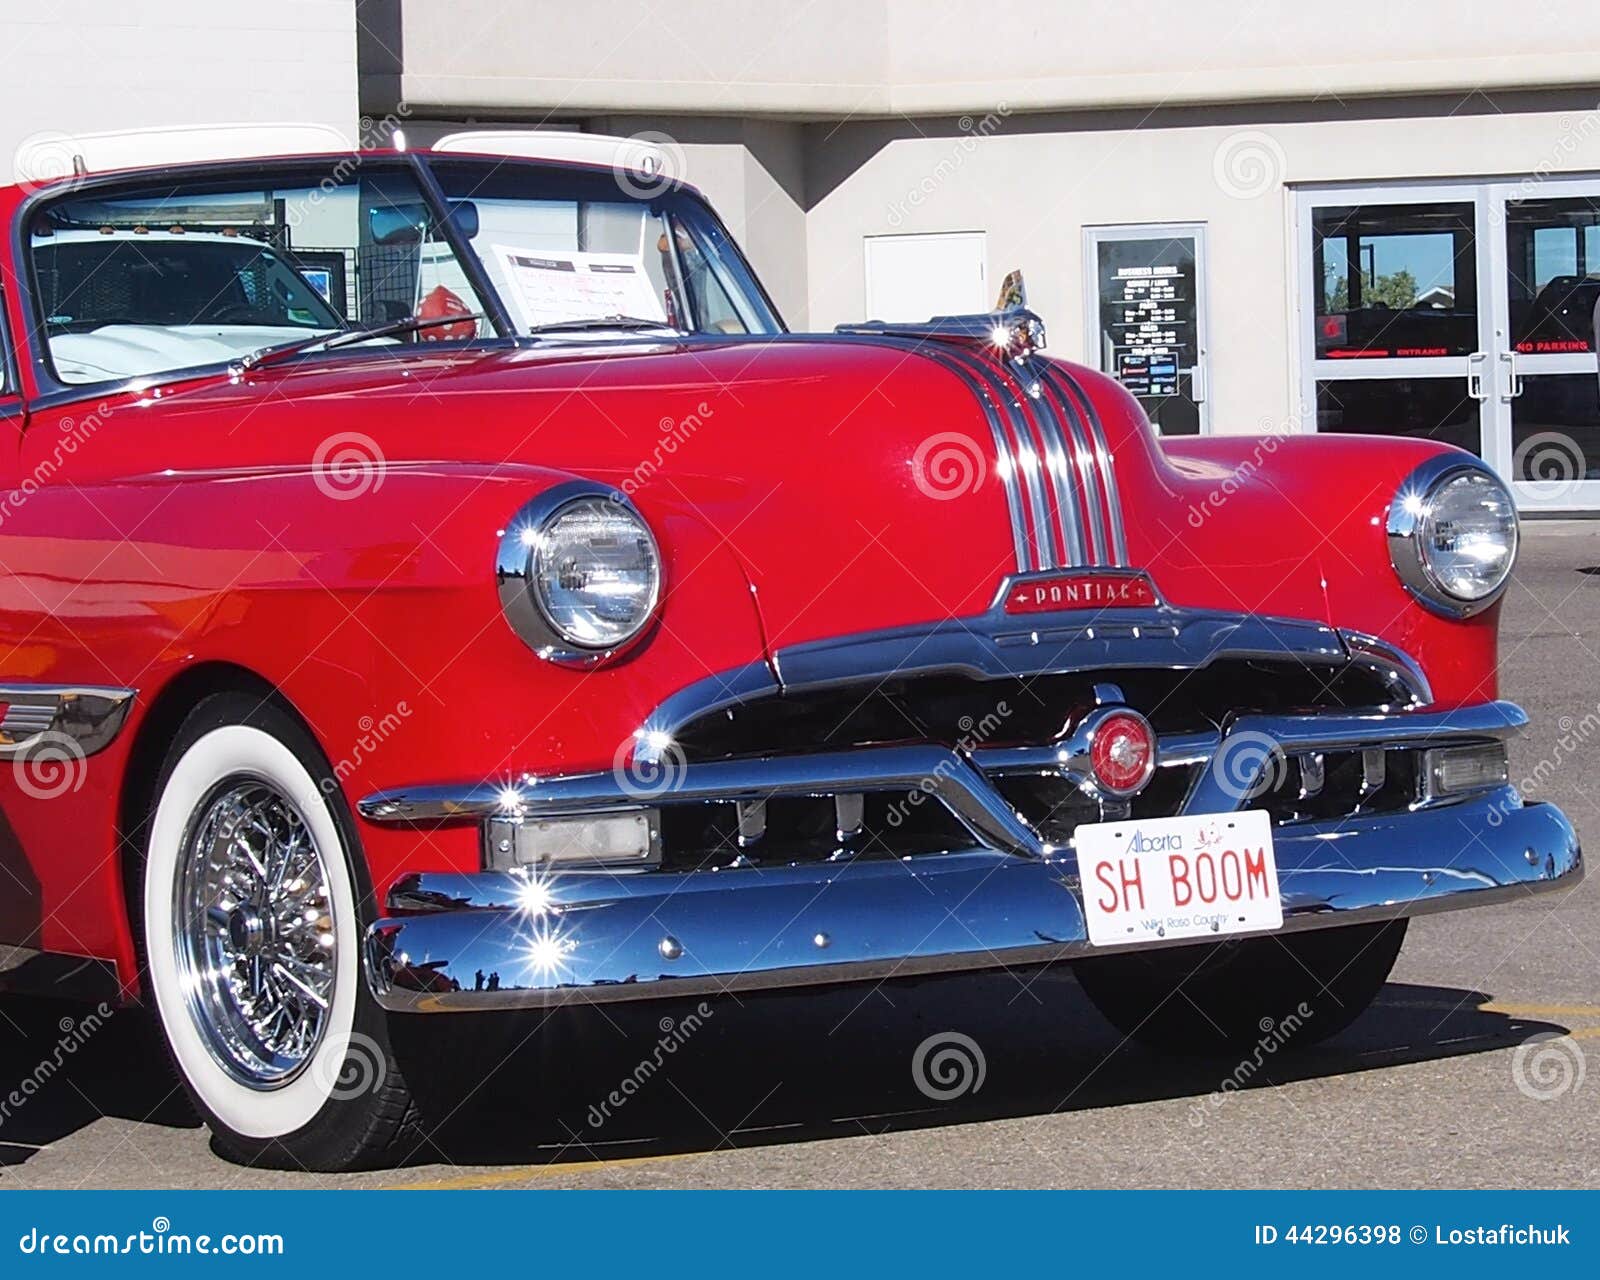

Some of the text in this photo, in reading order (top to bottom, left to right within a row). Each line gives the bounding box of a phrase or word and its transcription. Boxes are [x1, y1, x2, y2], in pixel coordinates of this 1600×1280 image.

[1397, 347, 1448, 356] ENTRANCE
[1516, 341, 1588, 352] NO PARKING
[1035, 583, 1129, 604] PONTIAC
[1125, 829, 1183, 854] Alberta
[1095, 847, 1269, 913] SH BOOM
[1140, 917, 1164, 931] Wild
[1193, 913, 1230, 926] Country
